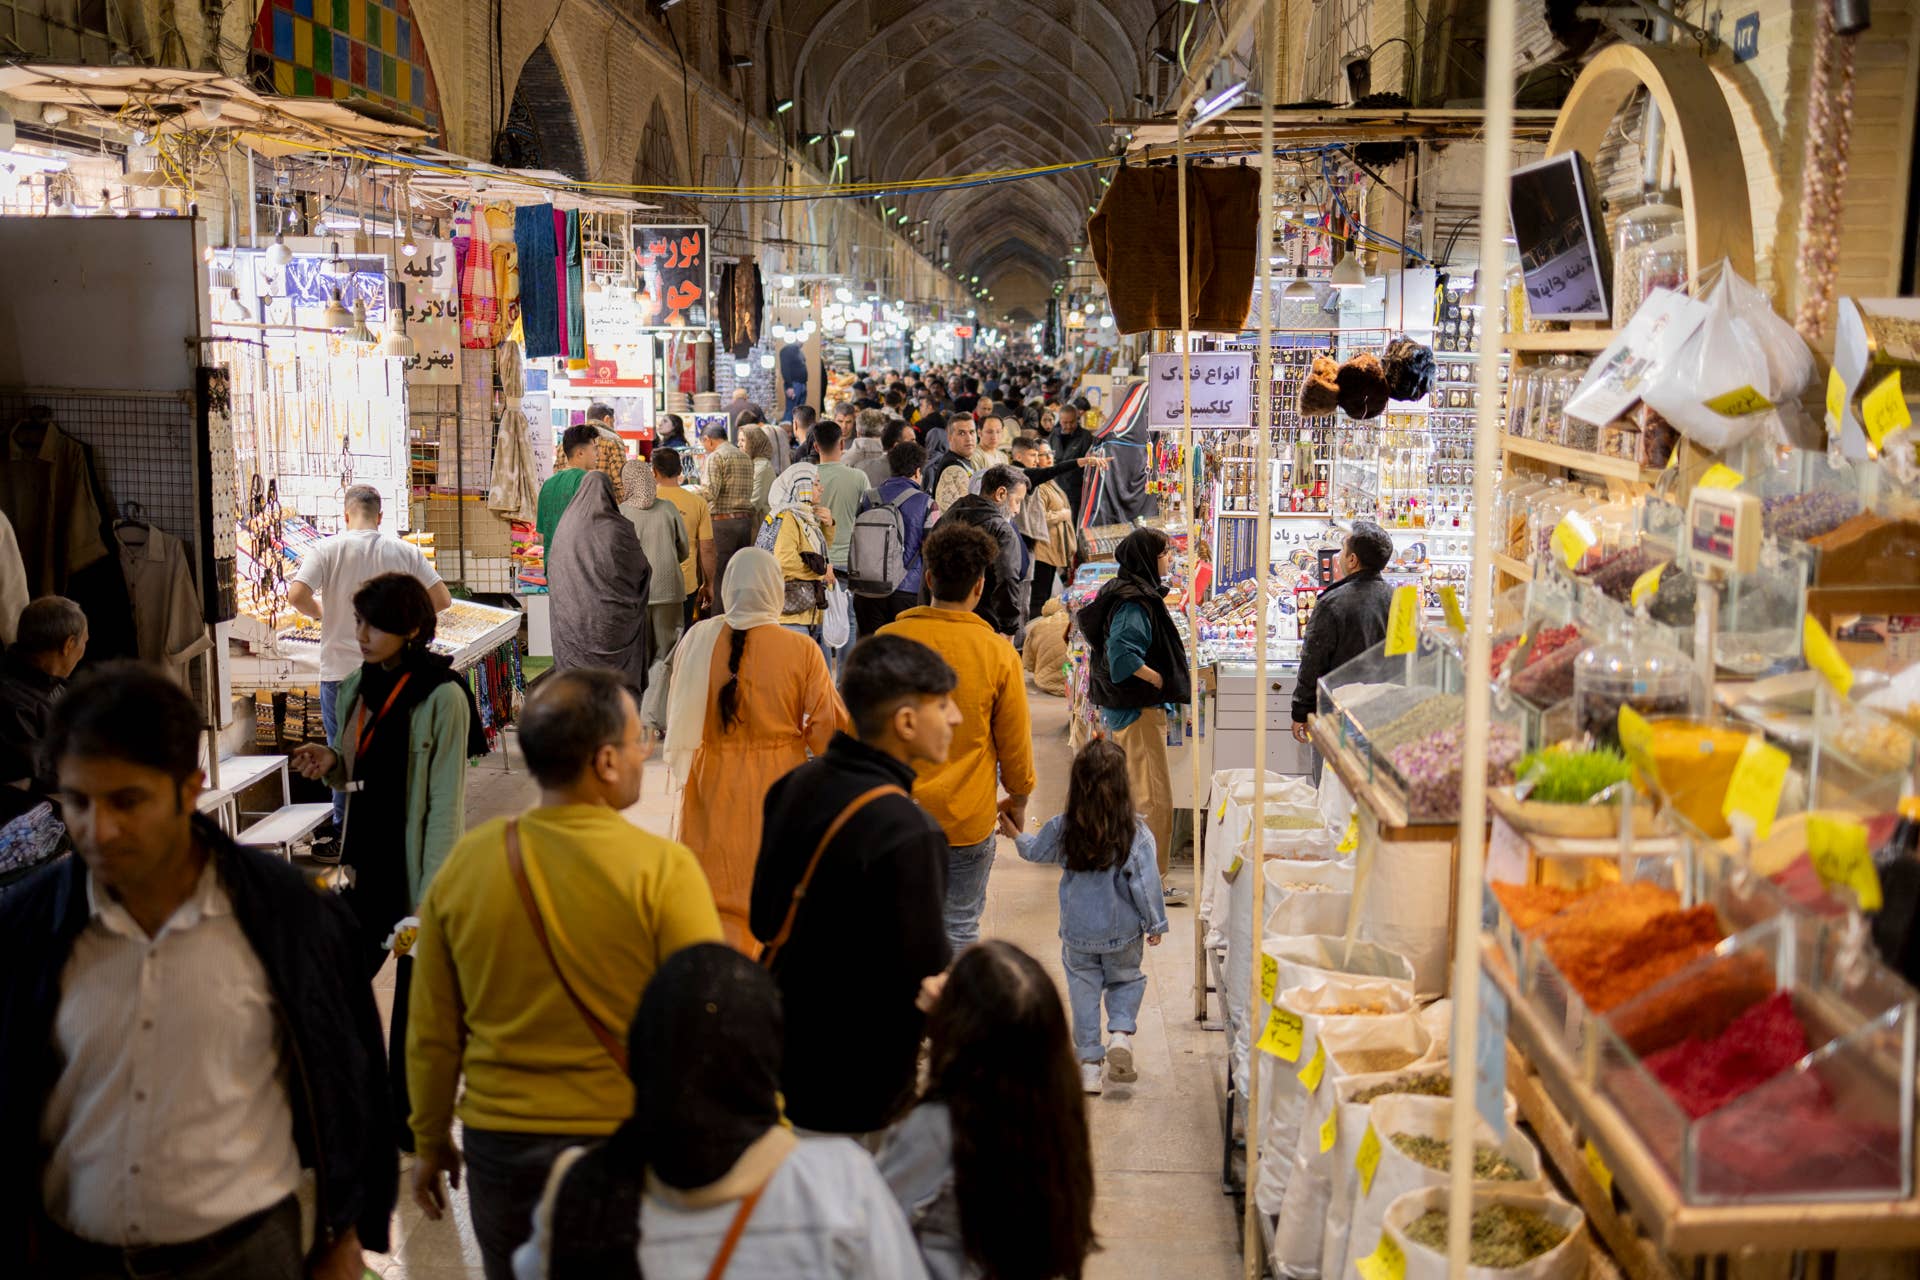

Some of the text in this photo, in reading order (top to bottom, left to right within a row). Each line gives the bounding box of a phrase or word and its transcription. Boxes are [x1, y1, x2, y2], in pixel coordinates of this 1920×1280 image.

[636, 231, 700, 268] بورس
[403, 254, 447, 284] کلبه
[642, 270, 702, 323] حول
[404, 299, 458, 323] بالاتری
[1204, 366, 1240, 385] انواع
[1166, 399, 1233, 419] کلکسینی
